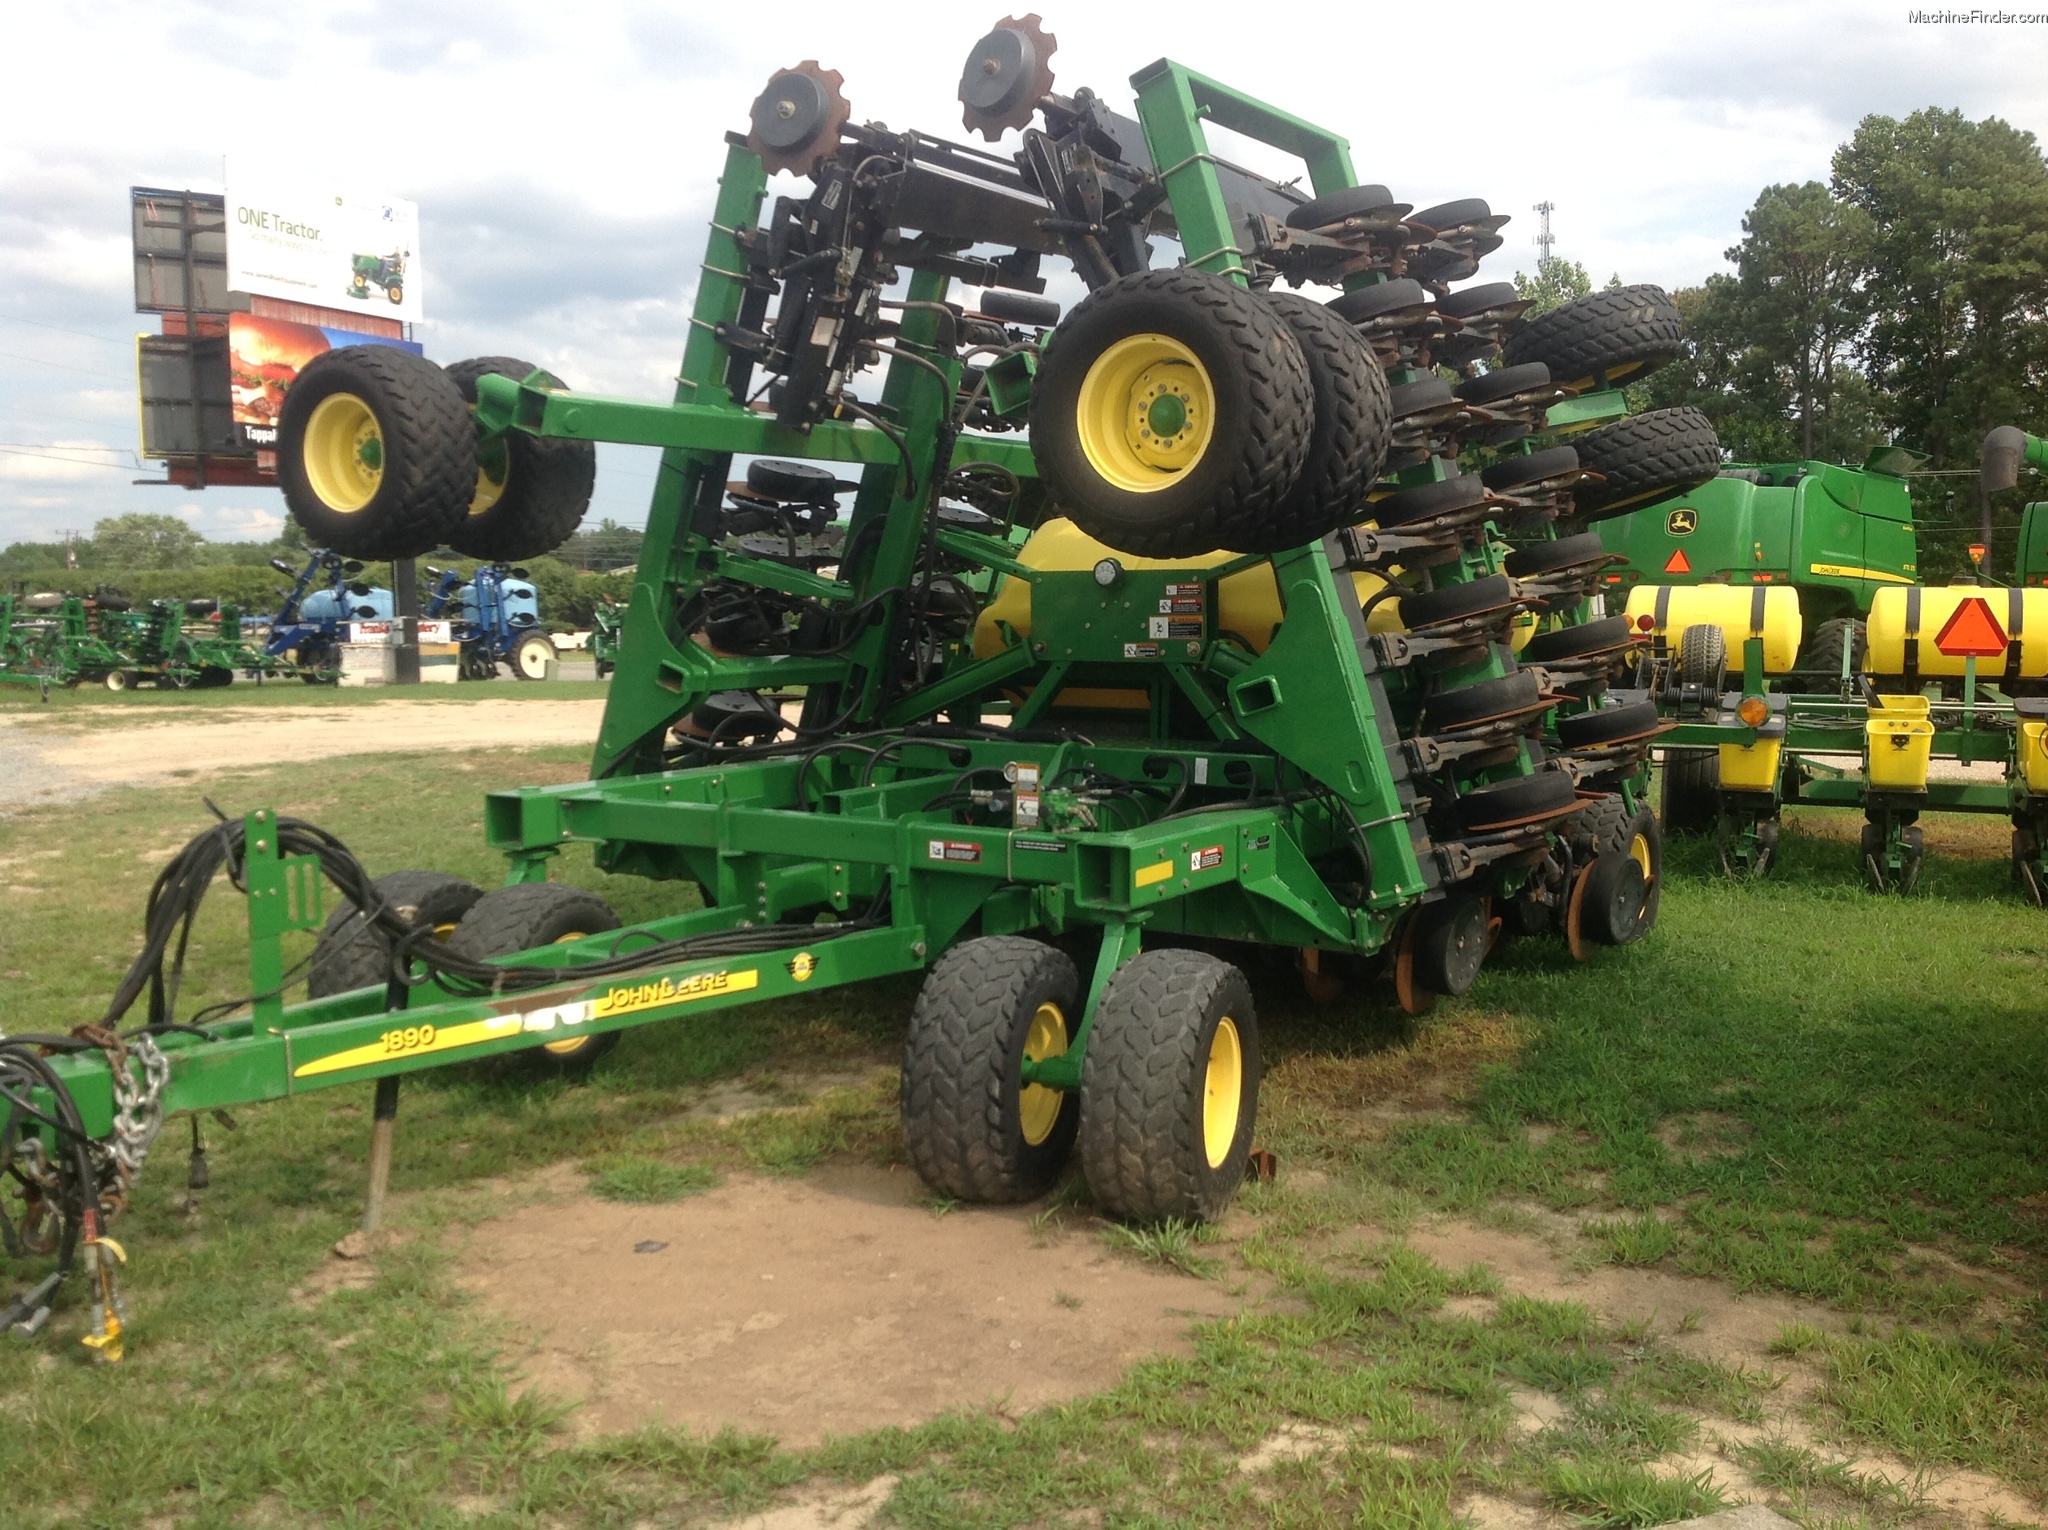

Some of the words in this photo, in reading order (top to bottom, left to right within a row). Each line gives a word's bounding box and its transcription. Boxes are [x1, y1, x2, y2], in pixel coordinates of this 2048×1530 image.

[238, 206, 269, 230] ONE
[272, 213, 323, 242] Tractor.
[602, 982, 660, 1011] JOHN
[660, 970, 728, 998] DEERE
[380, 1023, 436, 1053] 1890
